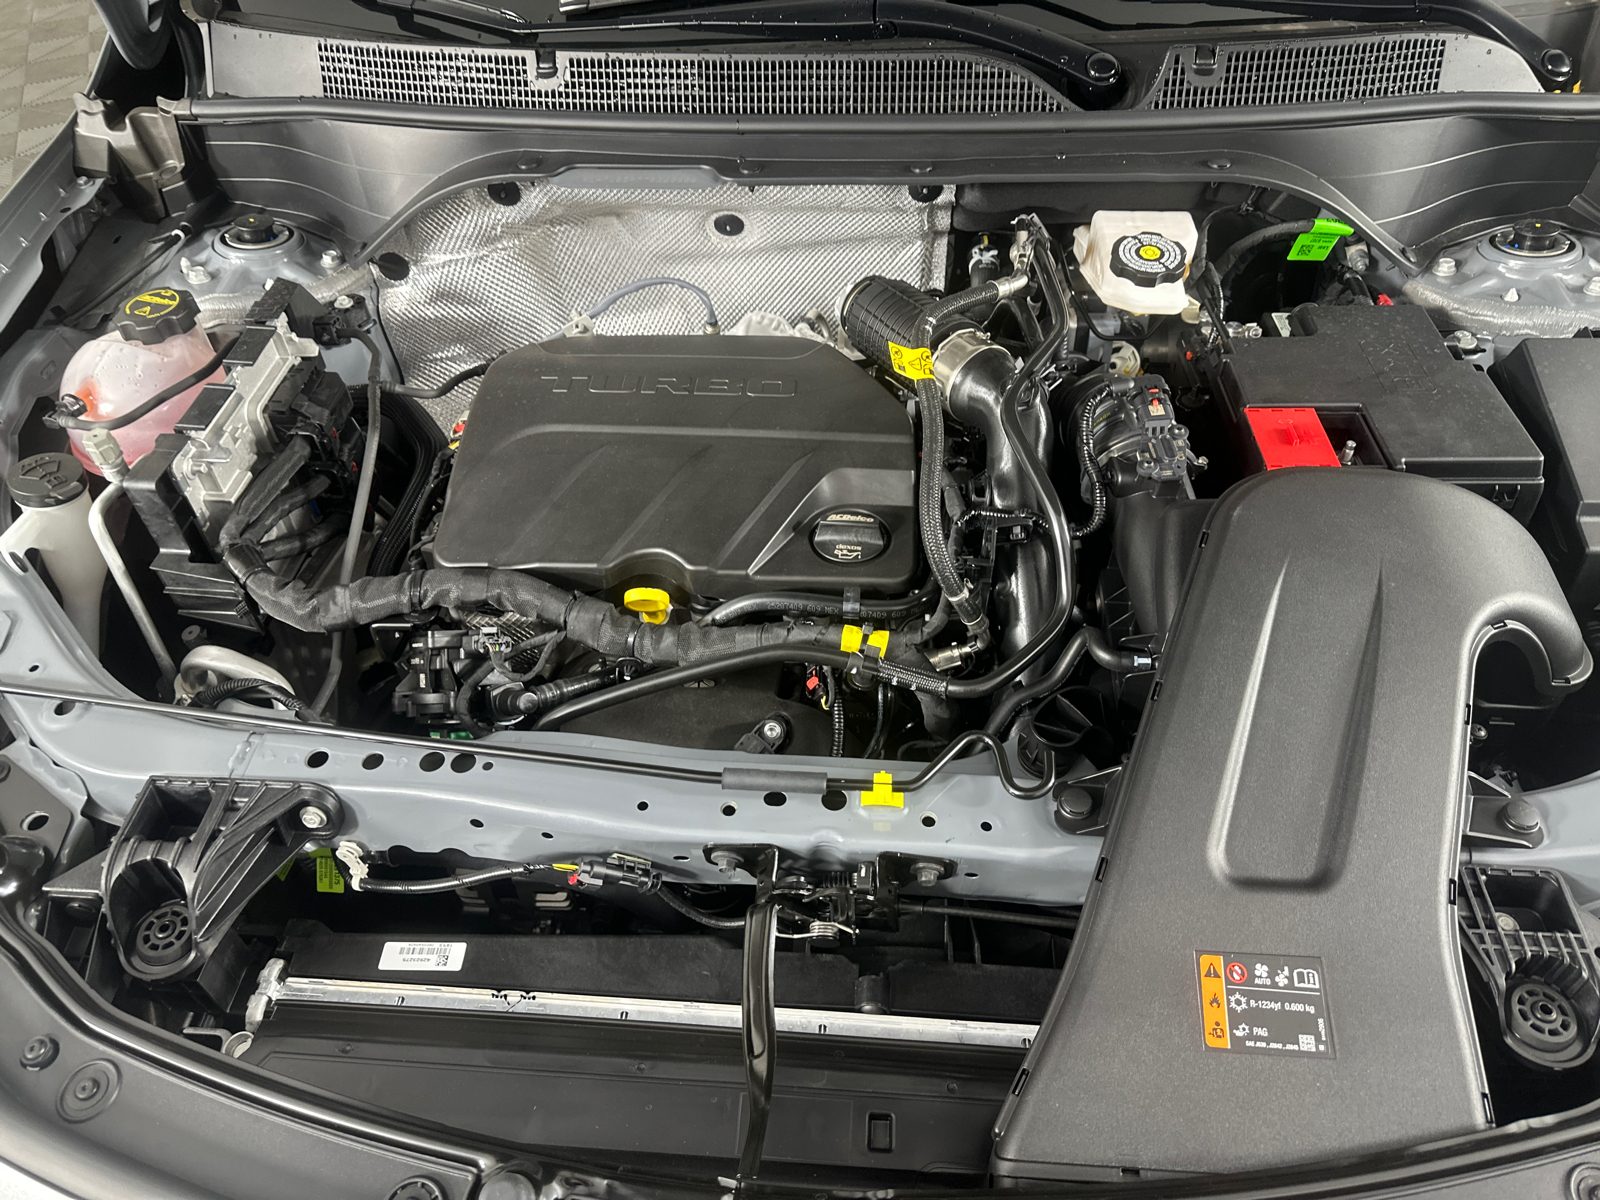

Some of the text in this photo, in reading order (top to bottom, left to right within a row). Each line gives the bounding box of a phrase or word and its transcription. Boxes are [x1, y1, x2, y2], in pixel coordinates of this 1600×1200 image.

[541, 374, 797, 397] TURBO
[826, 513, 875, 523] ACDelco
[835, 543, 862, 551] dexos
[807, 603, 822, 613] 609
[824, 606, 840, 615] MEX
[891, 609, 907, 618] 609
[1254, 978, 1271, 986] AUTO
[1249, 999, 1315, 1014] R-1234yf 0.600 kg
[1252, 1027, 1268, 1037] PAG
